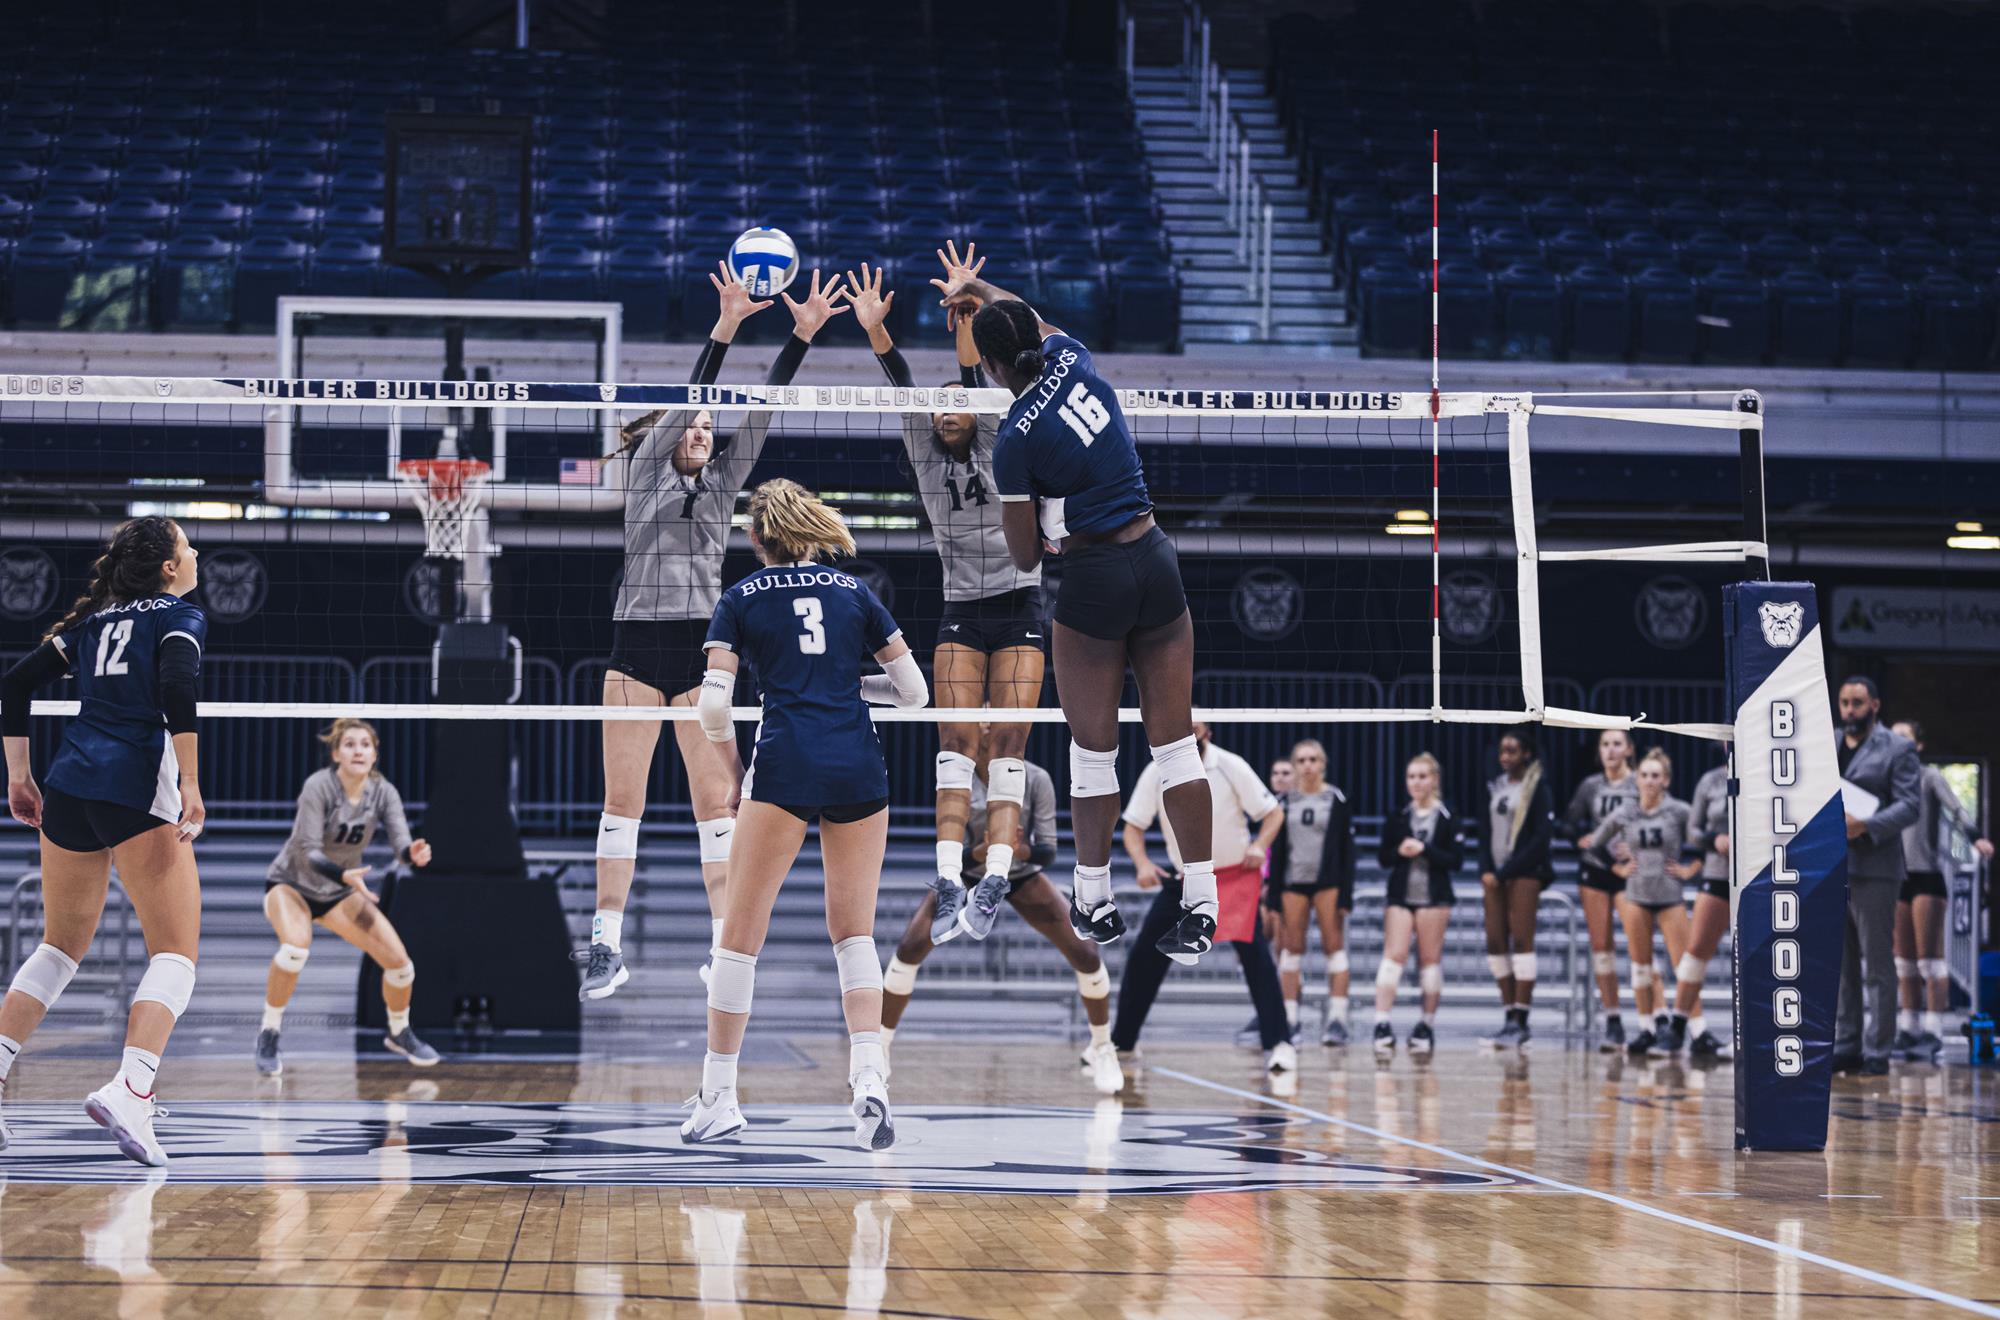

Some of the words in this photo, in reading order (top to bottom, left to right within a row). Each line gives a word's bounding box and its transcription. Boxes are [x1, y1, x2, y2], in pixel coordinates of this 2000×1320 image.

[0, 376, 84, 395] DOGS
[244, 379, 357, 398] BUTLER
[375, 380, 530, 401] BULLDOGS
[687, 384, 800, 405] BUTLER
[816, 387, 970, 407] BULLDOGS
[1015, 348, 1078, 436] BULLDOGS
[1124, 390, 1235, 408] BUTLER
[1253, 391, 1402, 410] BULLDOGS
[1057, 382, 1111, 448] 16
[680, 490, 698, 519] 1
[944, 473, 989, 511] 14
[740, 572, 858, 597] BULLDOGS
[792, 597, 827, 655] 3
[94, 619, 134, 677] 12
[333, 823, 366, 845] 16
[1639, 828, 1663, 848] 13
[1771, 700, 1804, 1077] BULLDOGS
